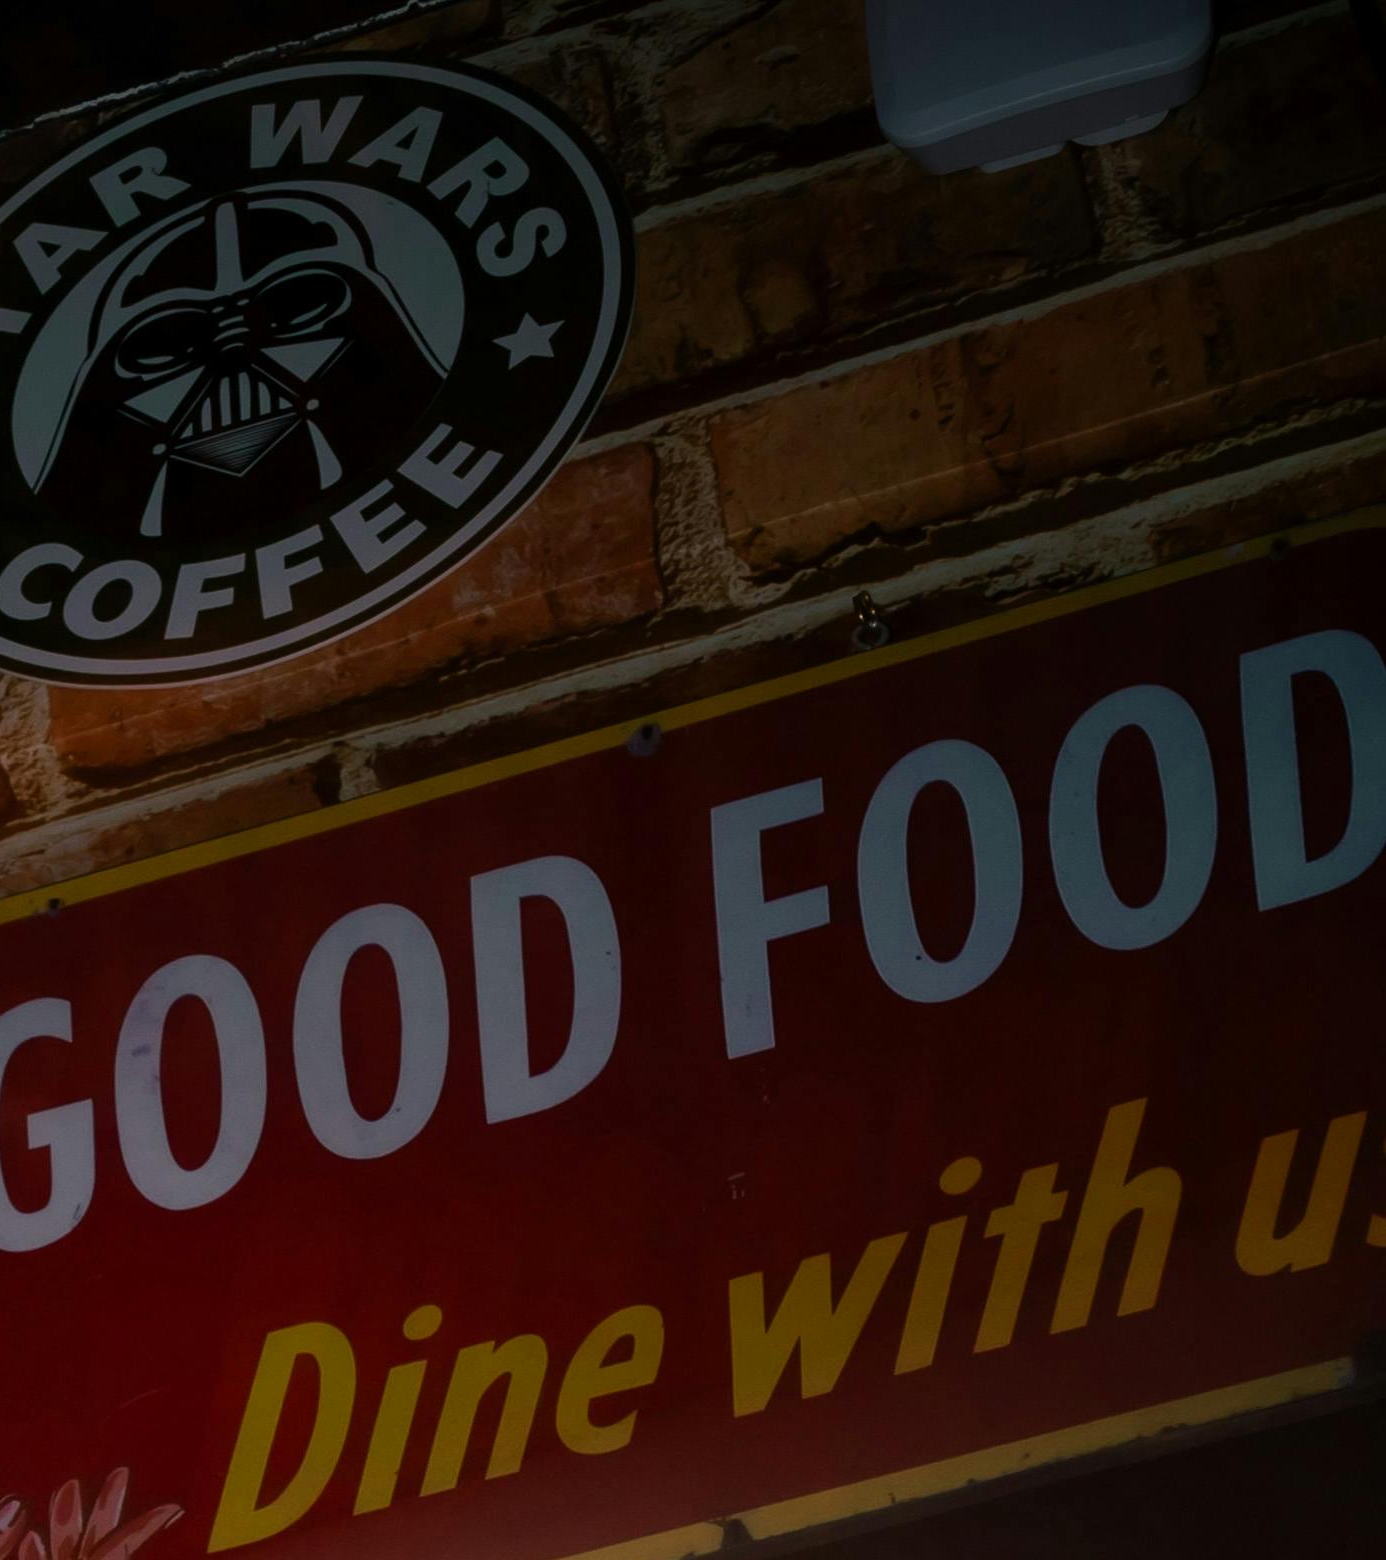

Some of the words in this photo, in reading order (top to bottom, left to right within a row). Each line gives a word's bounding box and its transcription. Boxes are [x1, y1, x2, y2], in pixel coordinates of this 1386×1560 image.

[248, 93, 567, 279] WARS
[708, 627, 1386, 1060] FOOD
[206, 1302, 664, 1554] Dine
[727, 1096, 1184, 1420] with
